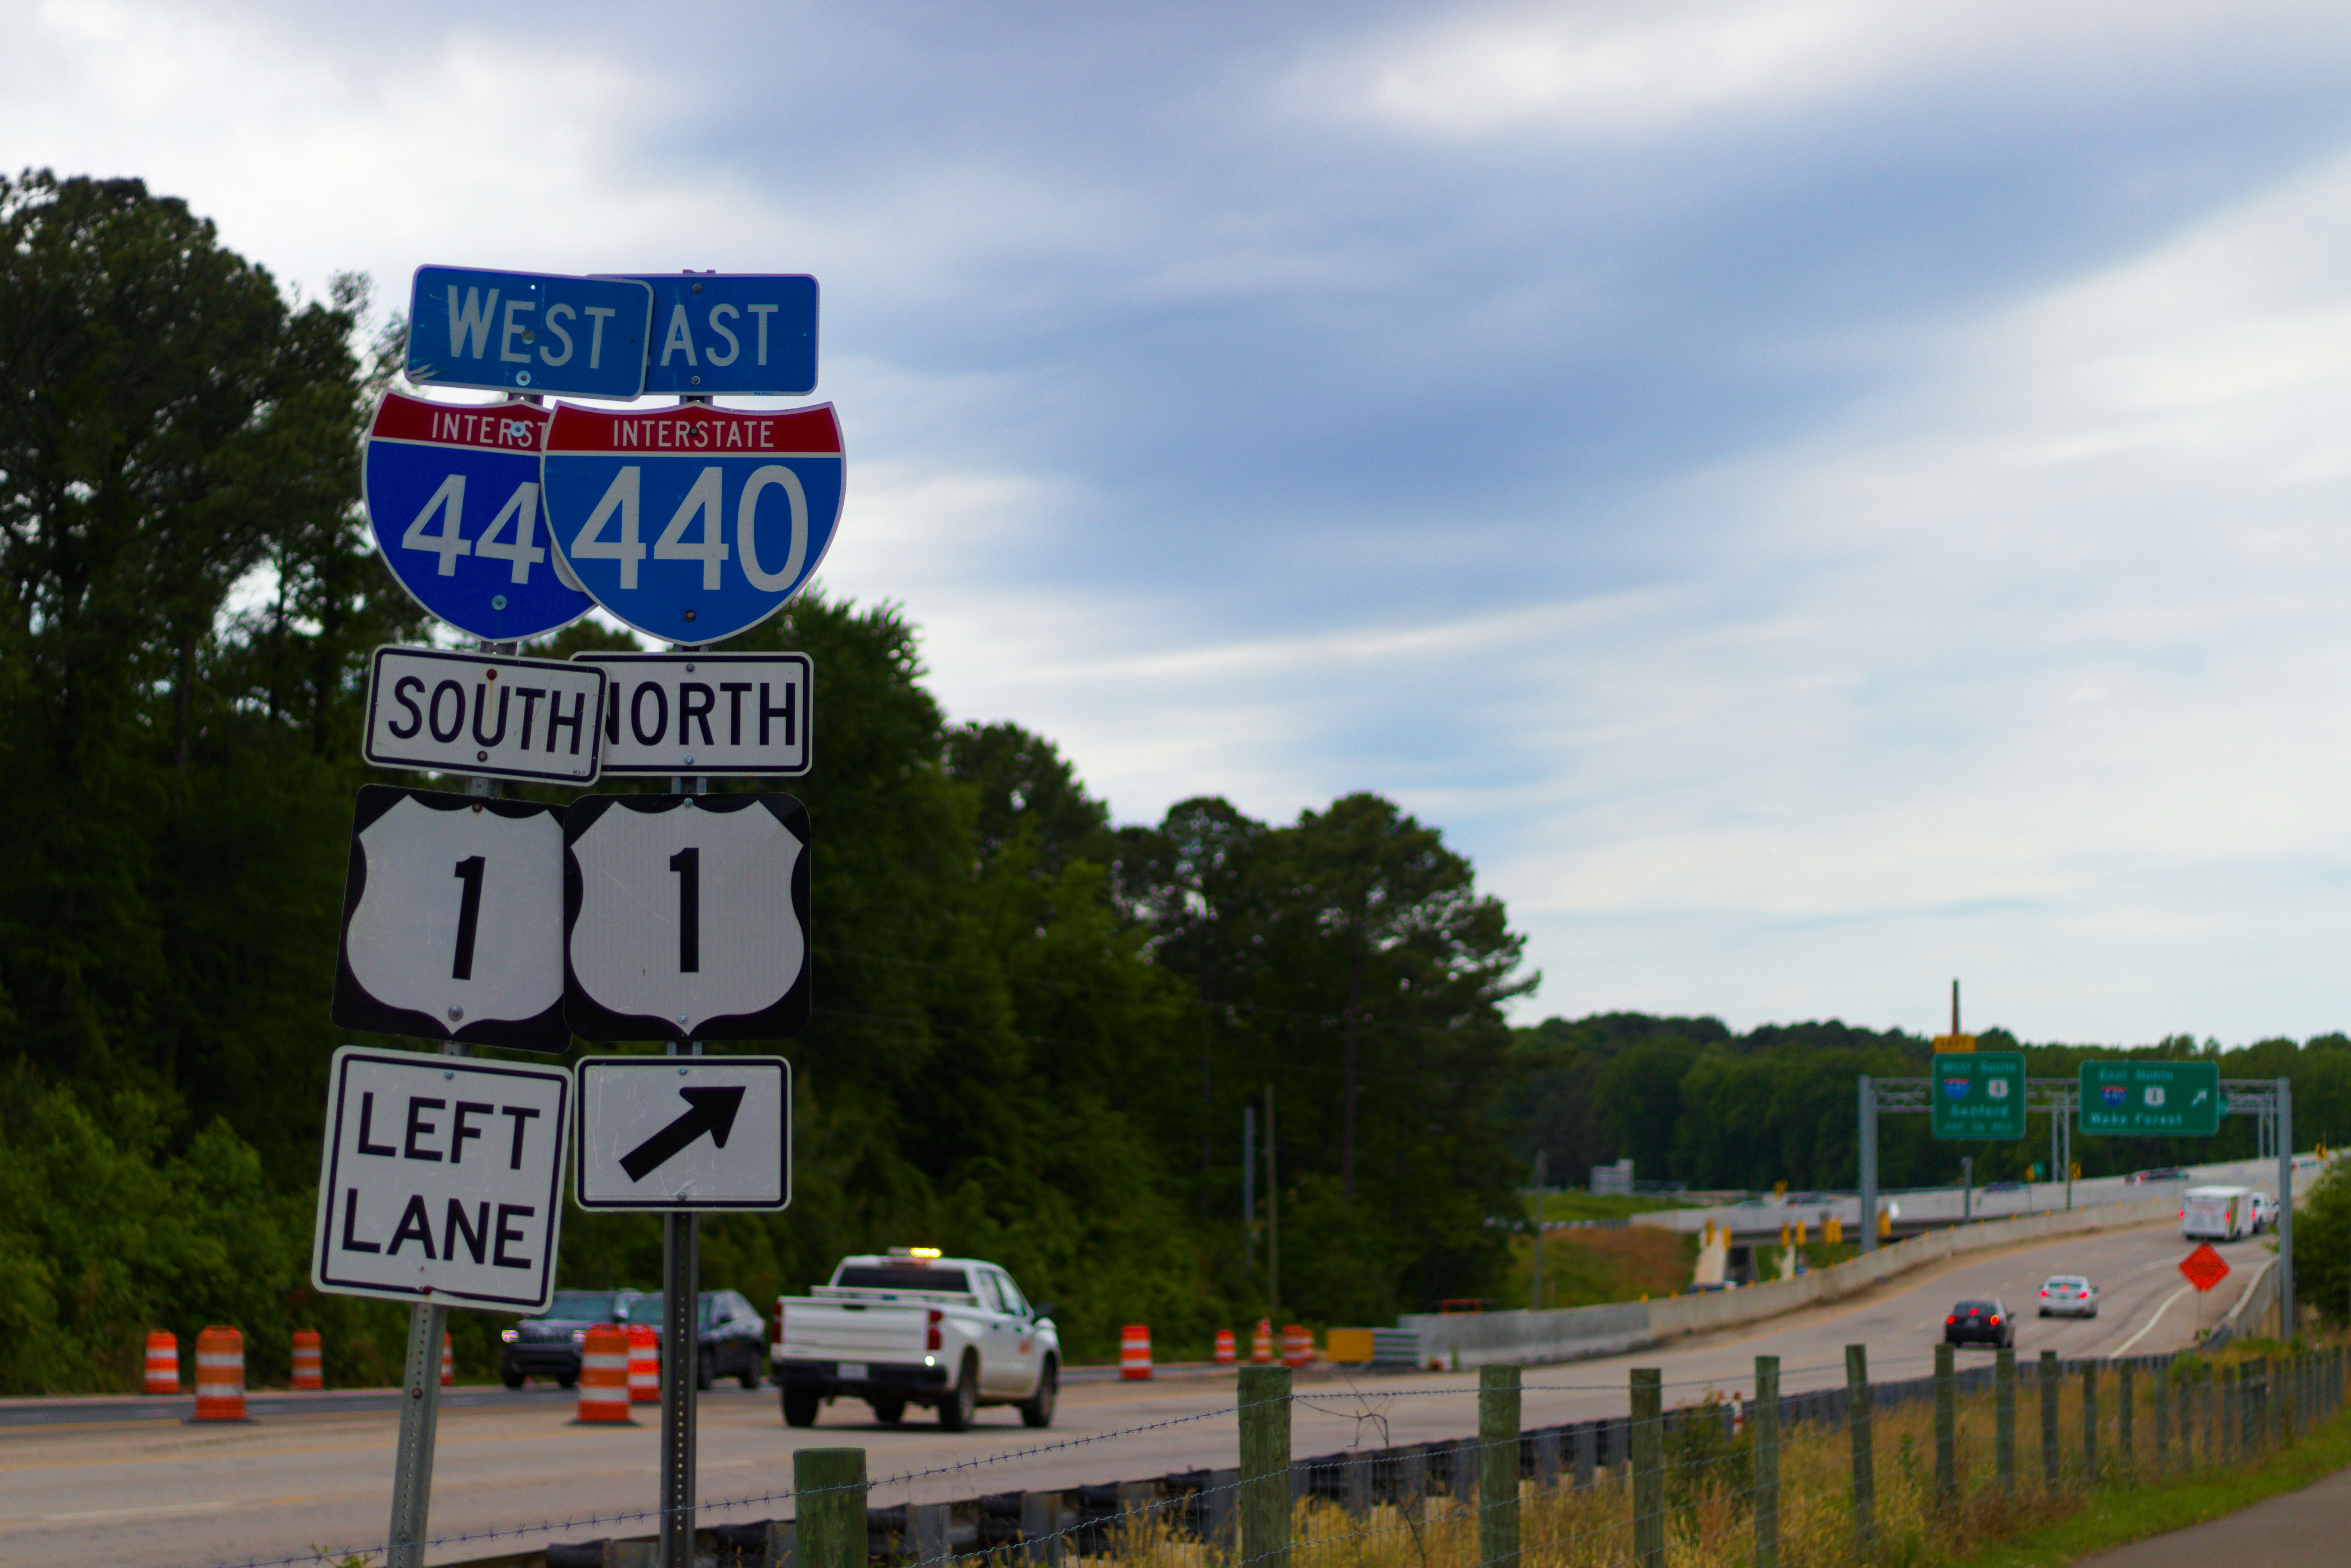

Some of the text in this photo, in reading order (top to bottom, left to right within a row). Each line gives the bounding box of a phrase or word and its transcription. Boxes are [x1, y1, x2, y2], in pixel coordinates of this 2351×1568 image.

[447, 284, 615, 369] WEST
[646, 303, 778, 367] AST
[431, 411, 547, 449] INTERST
[612, 420, 775, 448] INTERSTATE
[401, 473, 586, 592] 44
[571, 464, 809, 592] 440
[388, 675, 585, 755] SOUTH
[452, 855, 486, 981] 1
[669, 847, 699, 973] 1
[357, 1091, 540, 1170] LEFT
[342, 1187, 535, 1269] LANE
